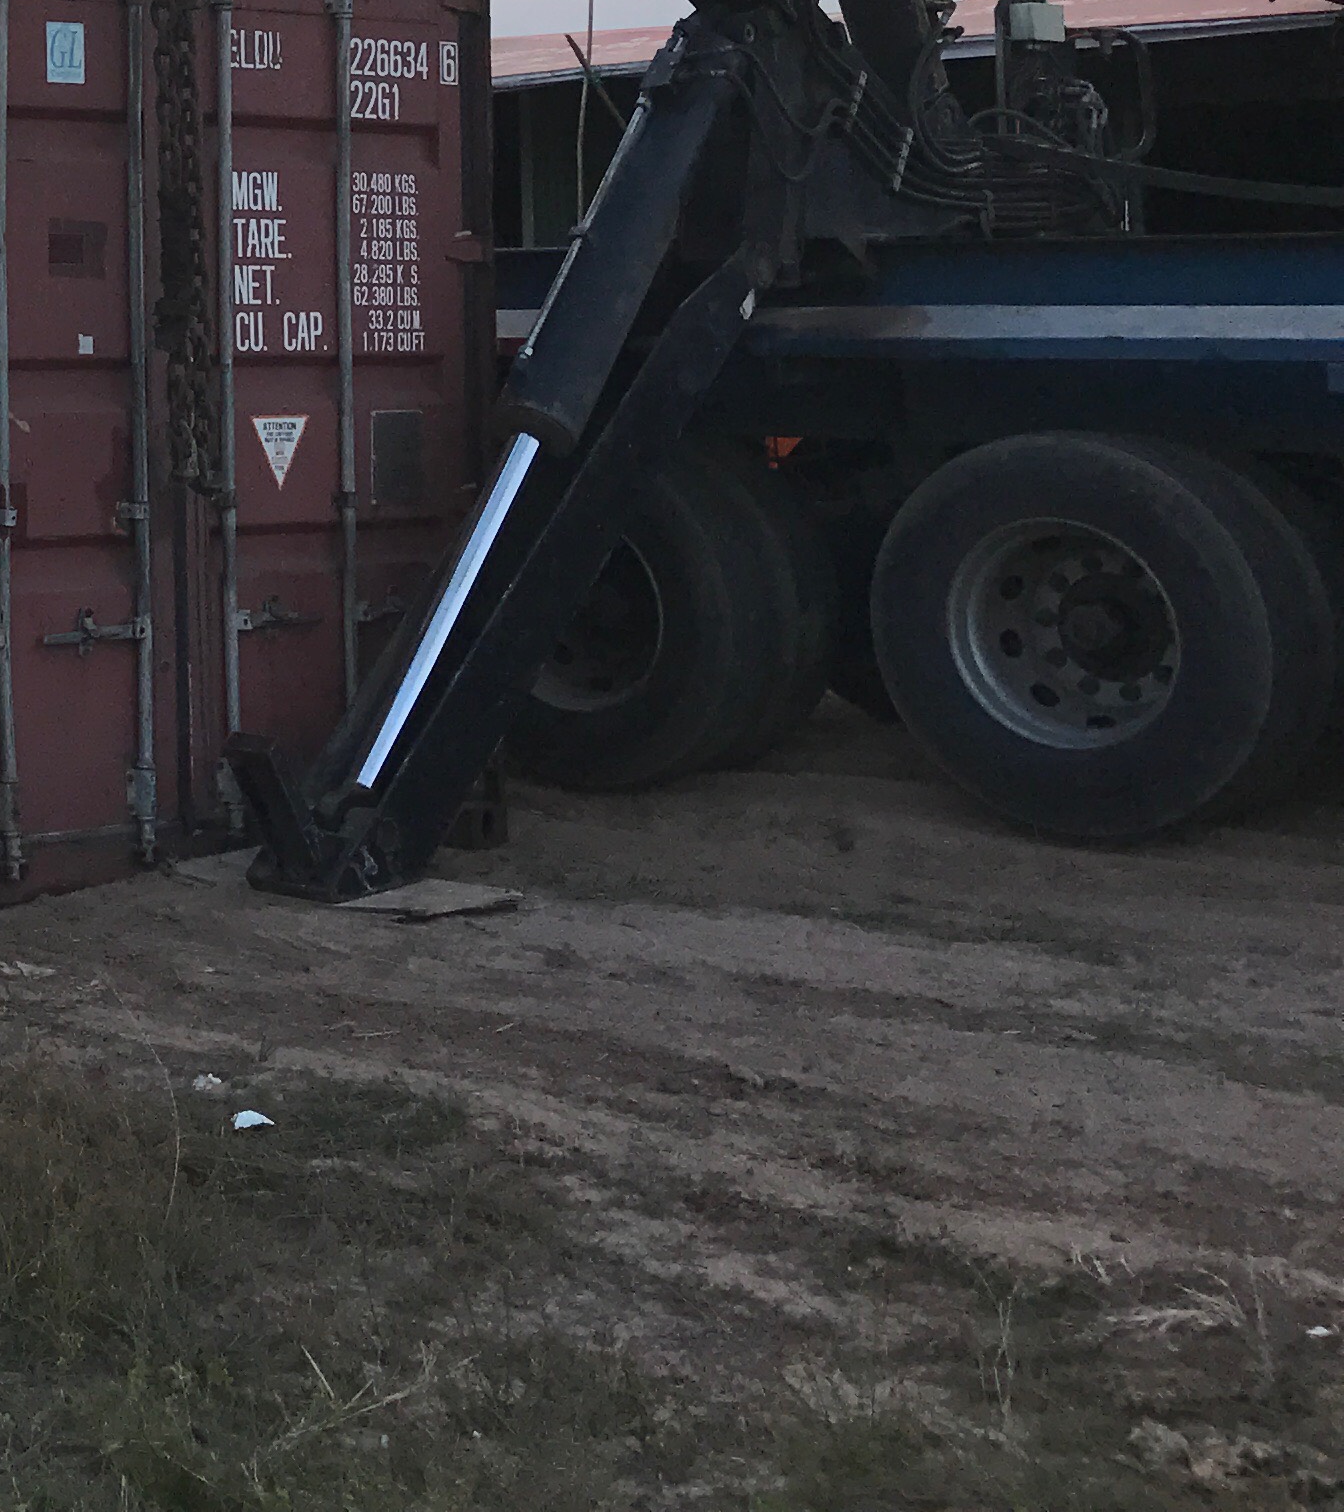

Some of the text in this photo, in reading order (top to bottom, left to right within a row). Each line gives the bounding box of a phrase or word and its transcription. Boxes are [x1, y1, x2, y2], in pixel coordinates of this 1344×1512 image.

[351, 38, 455, 81] 226634 6
[351, 81, 399, 120] 22G1
[232, 172, 282, 211] MGW.
[395, 174, 418, 194] KGS.
[395, 196, 419, 216] LBS.
[233, 218, 292, 258] TARE.
[397, 241, 420, 261] LBS.
[235, 265, 280, 305] NET.
[398, 287, 420, 306] LBS.
[235, 312, 327, 351] CU. CAP.
[369, 310, 394, 330] 33.2
